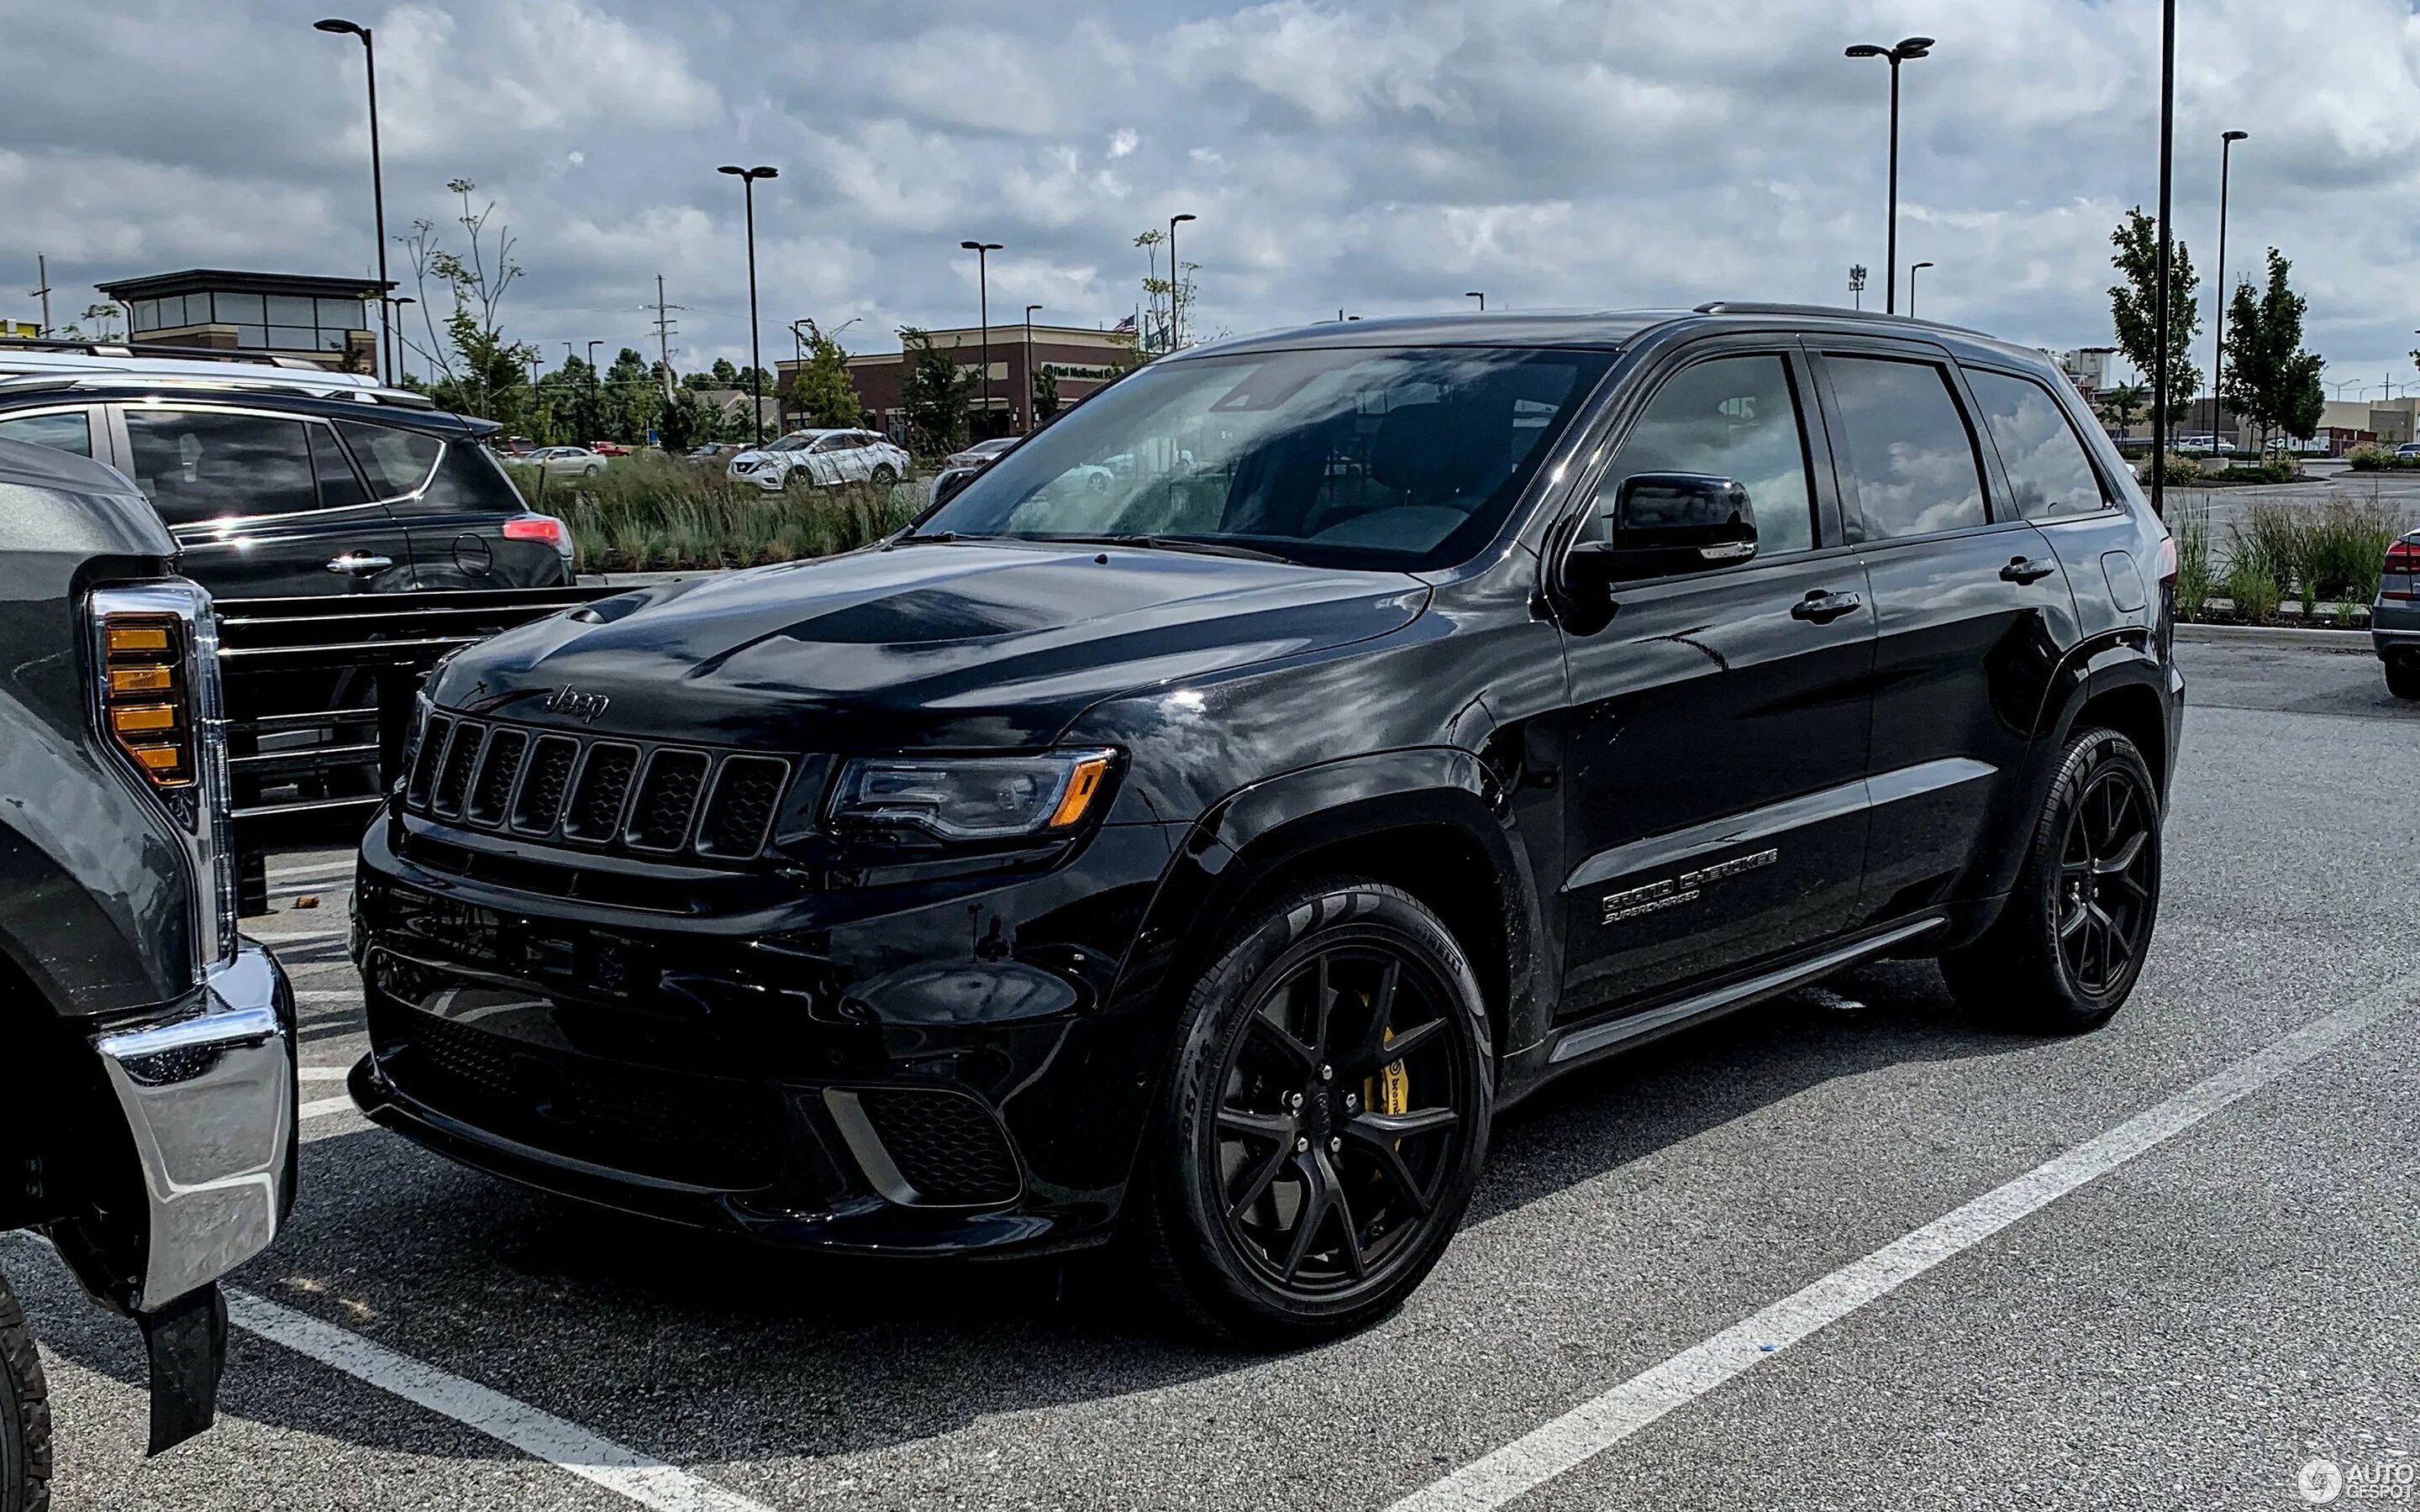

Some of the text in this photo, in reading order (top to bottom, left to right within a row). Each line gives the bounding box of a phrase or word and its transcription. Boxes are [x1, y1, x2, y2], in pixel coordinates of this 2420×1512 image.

[544, 683, 611, 724] Jeep
[1602, 848, 1779, 912] GRAND CHEROKEE
[1602, 889, 1701, 926] SUPERCHARGED
[1392, 1078, 1401, 1115] bremb
